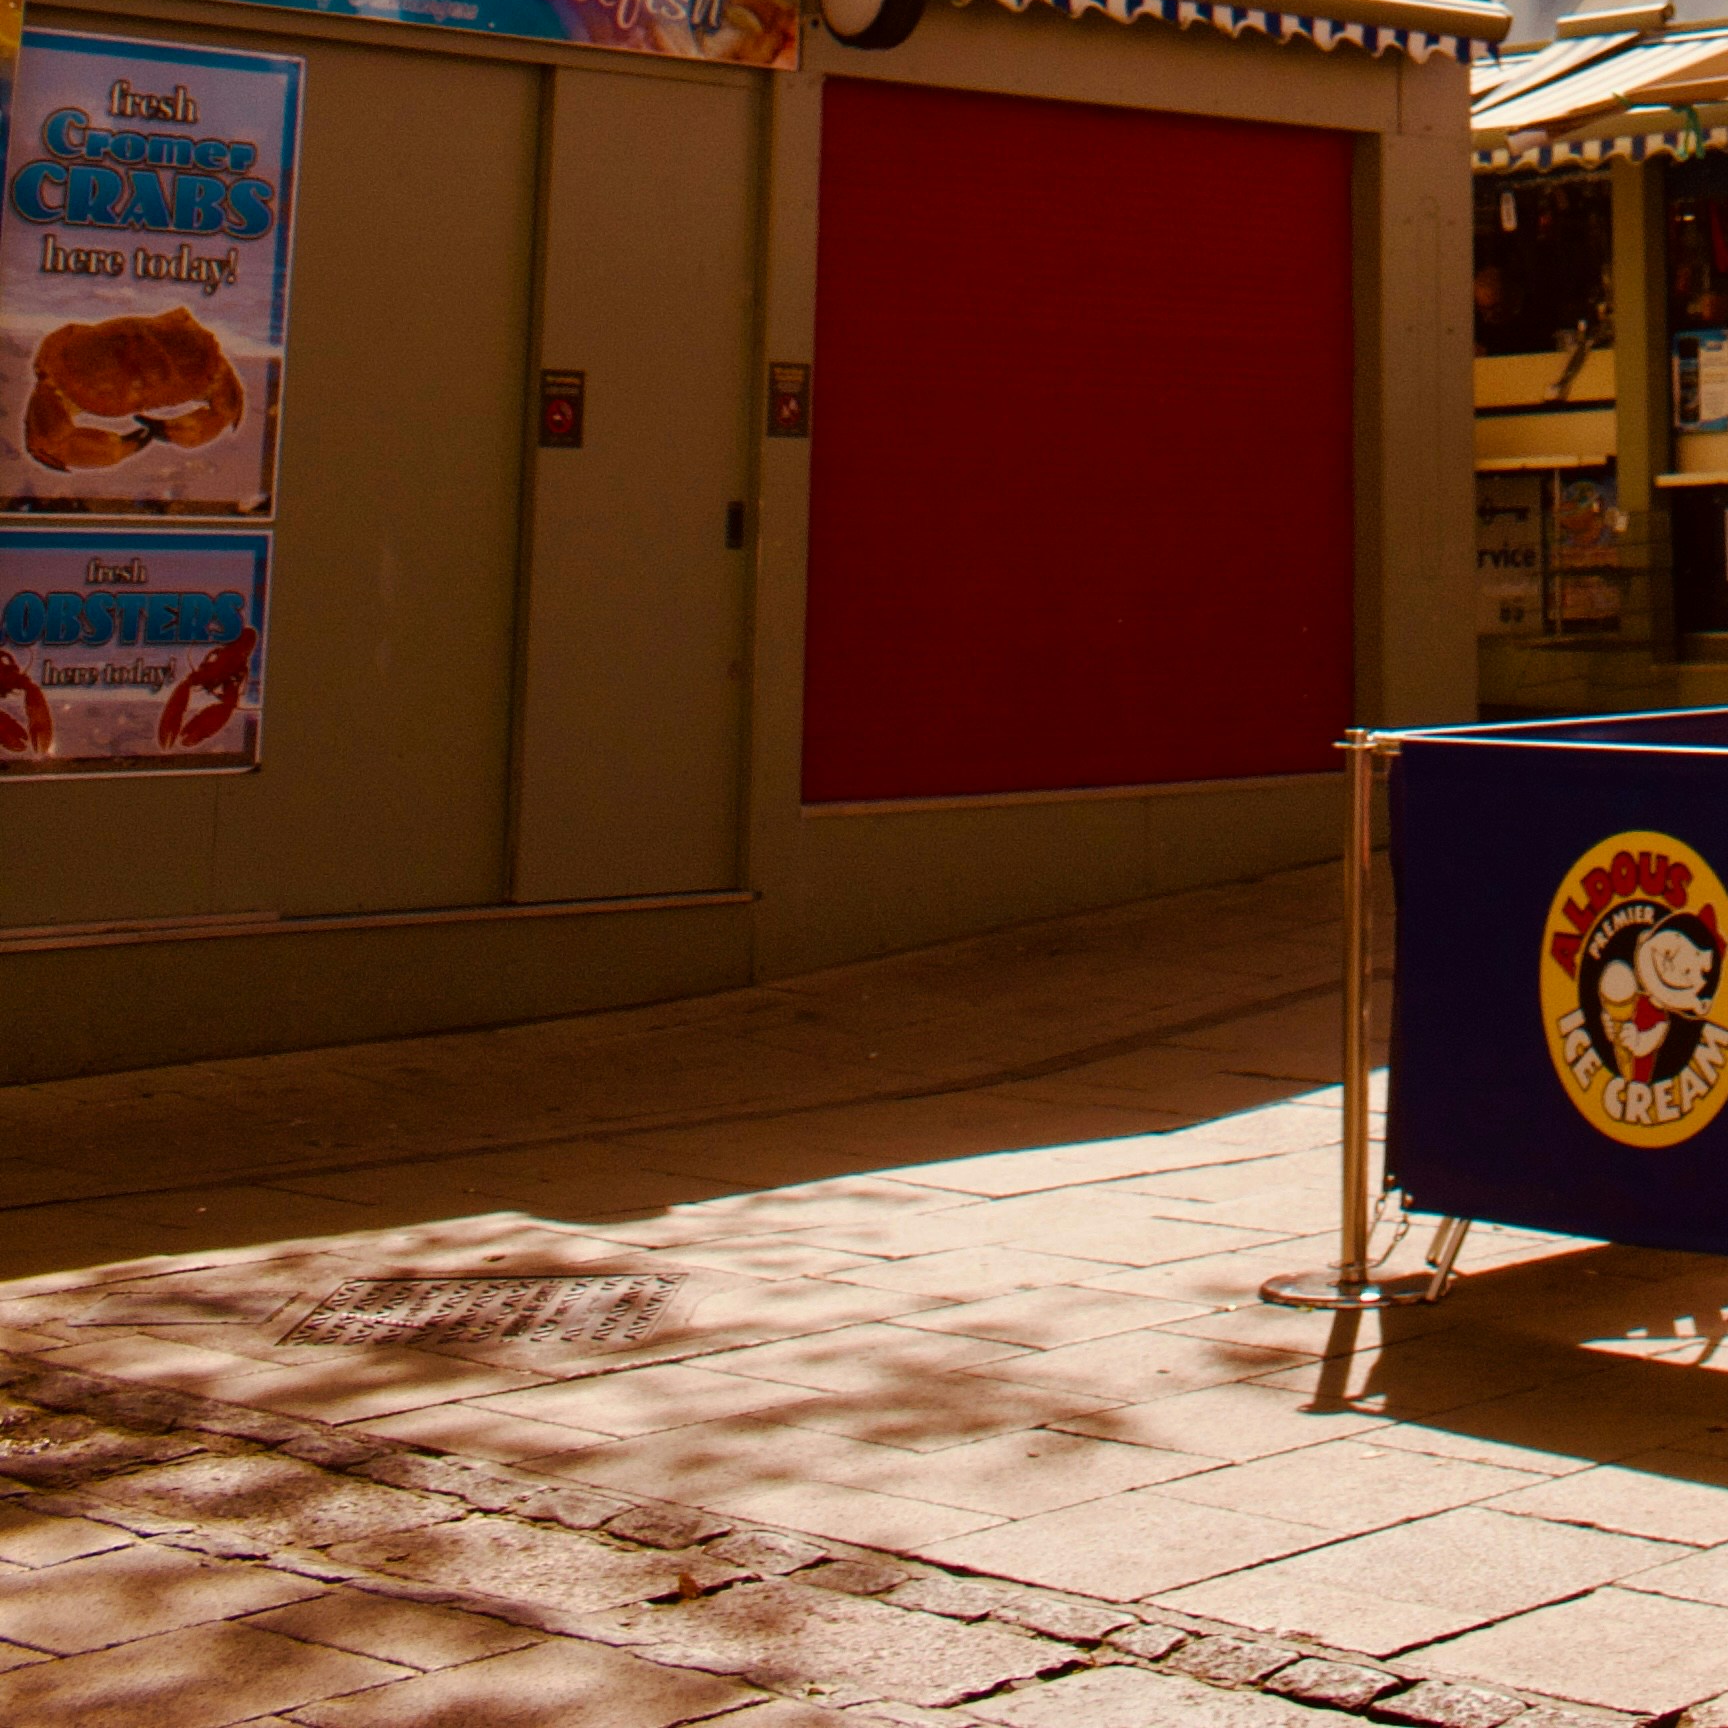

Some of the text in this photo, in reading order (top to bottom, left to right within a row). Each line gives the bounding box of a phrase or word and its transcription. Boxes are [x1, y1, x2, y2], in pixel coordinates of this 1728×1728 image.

[109, 78, 200, 124] fresh
[43, 105, 258, 175] Cromer
[10, 159, 277, 240] CRABS
[41, 232, 240, 295] here today!
[85, 557, 148, 586] fresh
[1477, 545, 1536, 568] rvice
[0, 589, 246, 648] OBSTERS
[40, 656, 178, 694] here today!
[1550, 850, 1693, 982] ALDOUS
[1588, 904, 1657, 961] PREMIER
[1556, 1007, 1605, 1094] ICE
